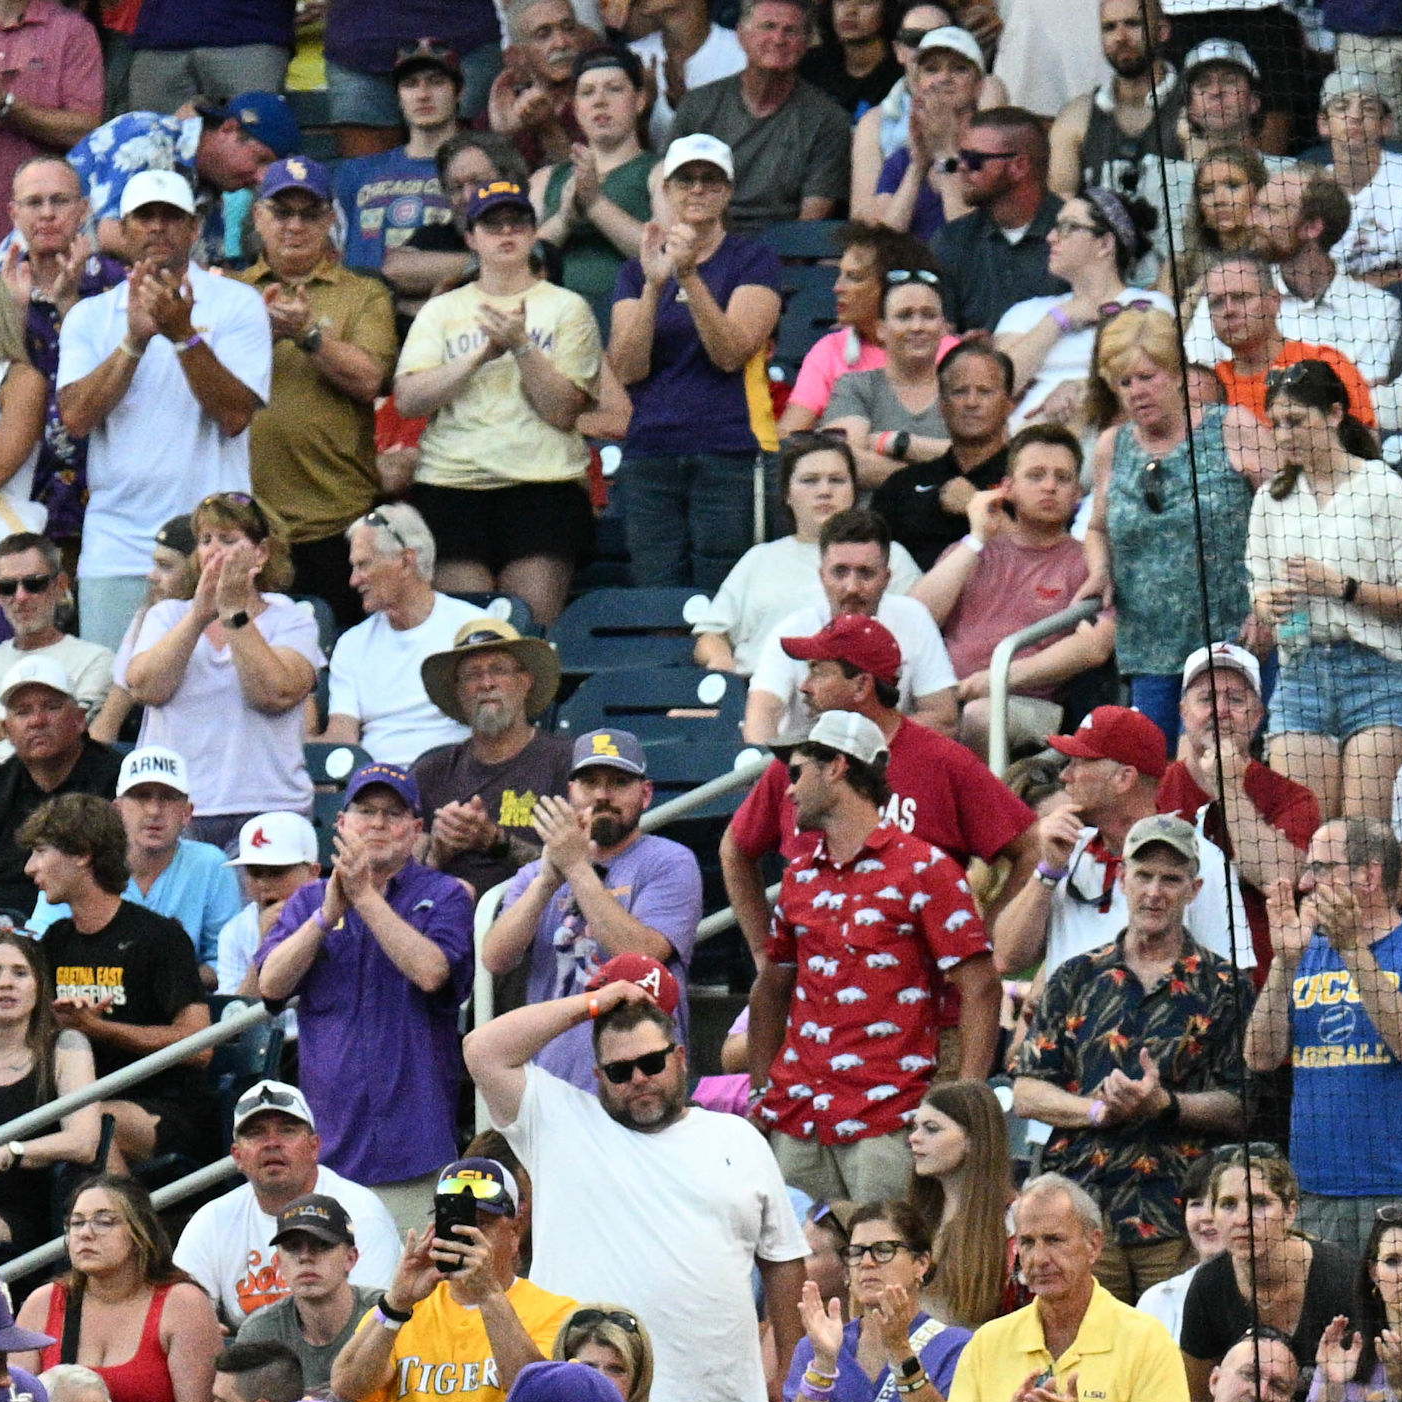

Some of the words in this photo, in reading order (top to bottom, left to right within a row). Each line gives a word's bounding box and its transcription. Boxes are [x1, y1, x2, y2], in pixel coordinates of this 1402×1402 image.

[128, 753, 178, 777] ARNIE
[96, 966, 125, 985] EAST
[1083, 1389, 1108, 1402] LSU
